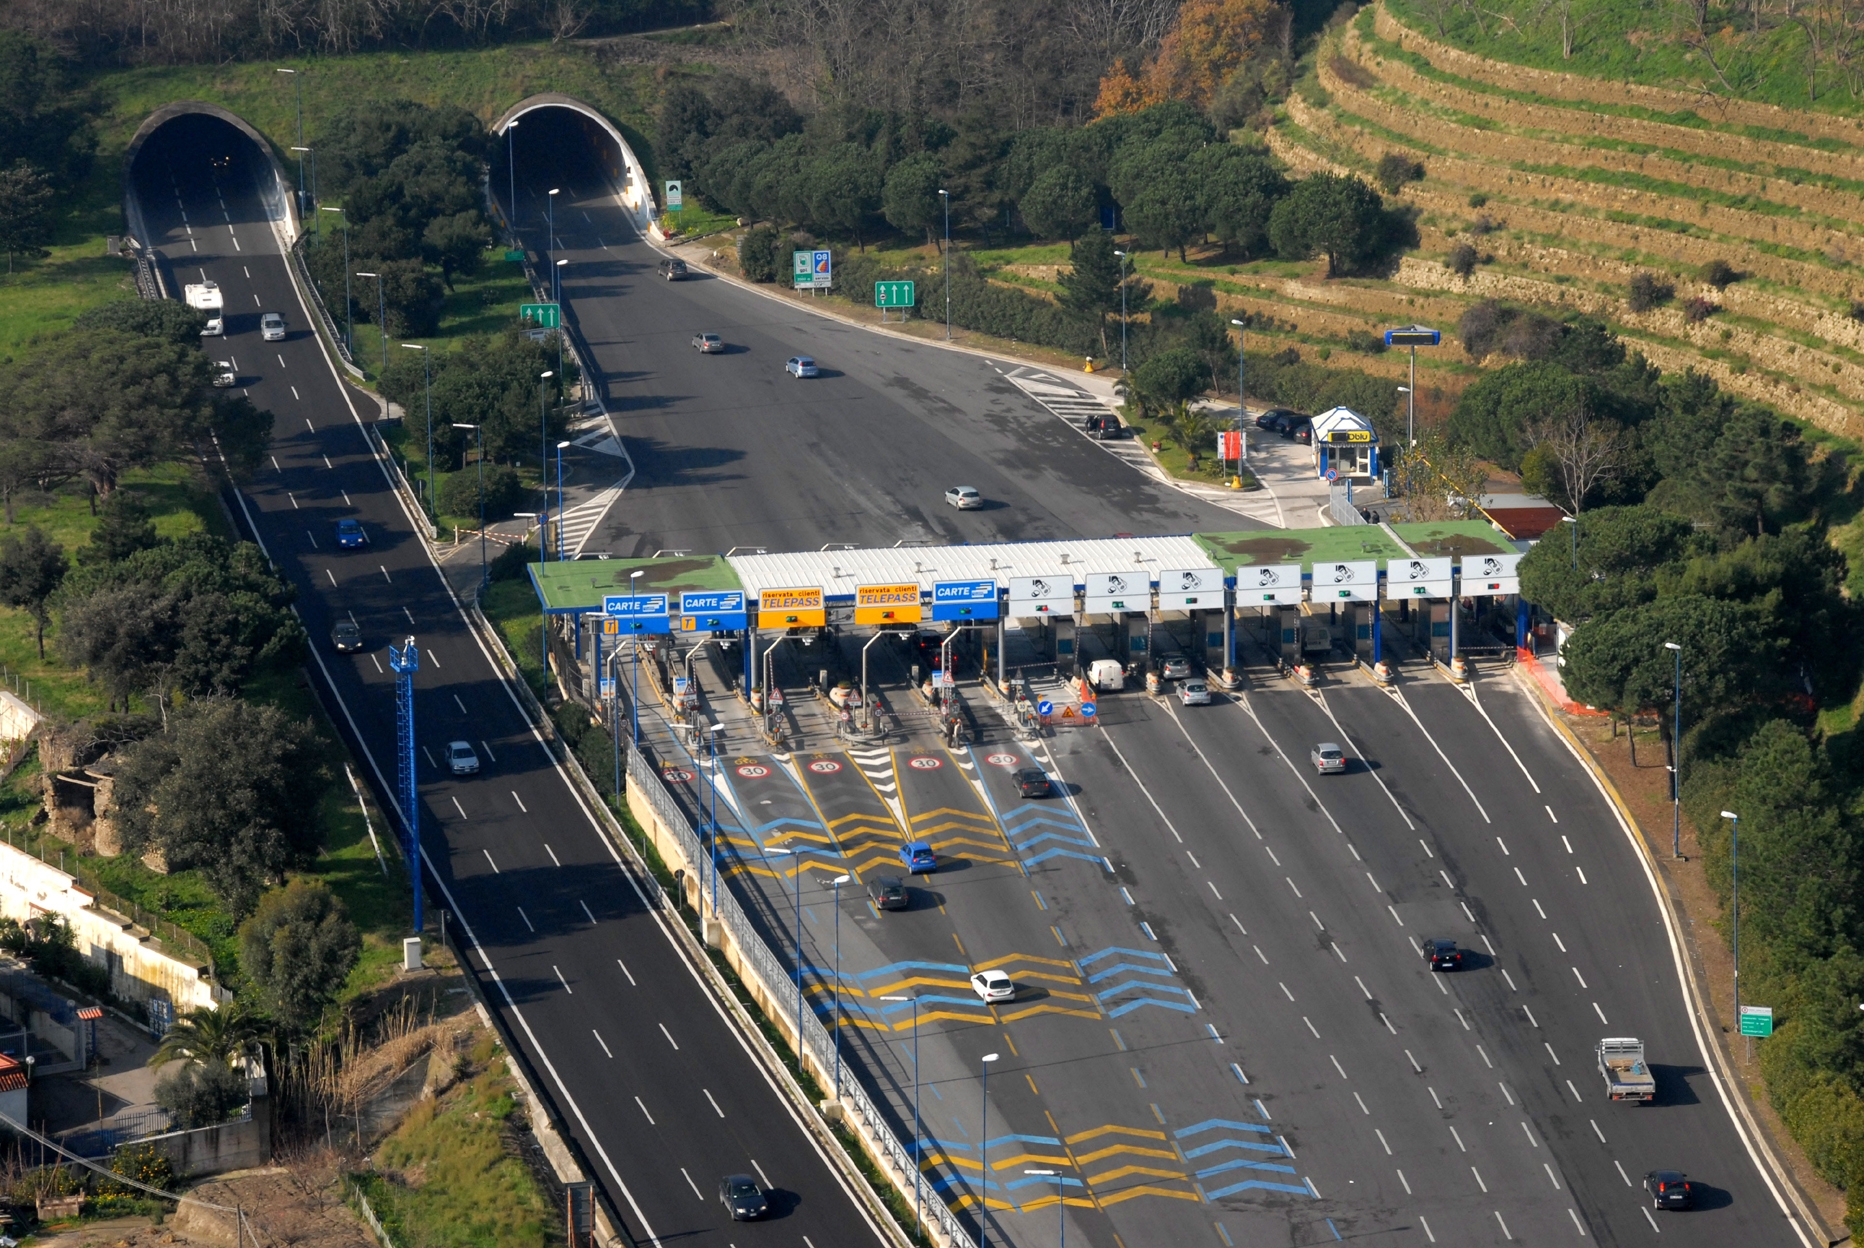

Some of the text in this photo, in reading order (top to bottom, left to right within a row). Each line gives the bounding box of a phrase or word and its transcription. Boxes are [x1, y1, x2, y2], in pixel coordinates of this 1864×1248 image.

[895, 585, 917, 593] clienti
[937, 586, 970, 597] CARTE
[685, 598, 718, 608] CARTE
[763, 597, 820, 609] TELEPASS
[860, 593, 917, 604] TELEPASS
[607, 601, 641, 611] CARTE
[685, 618, 693, 629] T
[915, 759, 937, 767] 30
[992, 755, 1014, 764] 30
[742, 767, 764, 775] 30
[814, 763, 836, 771] 30
[666, 771, 689, 780] 30
